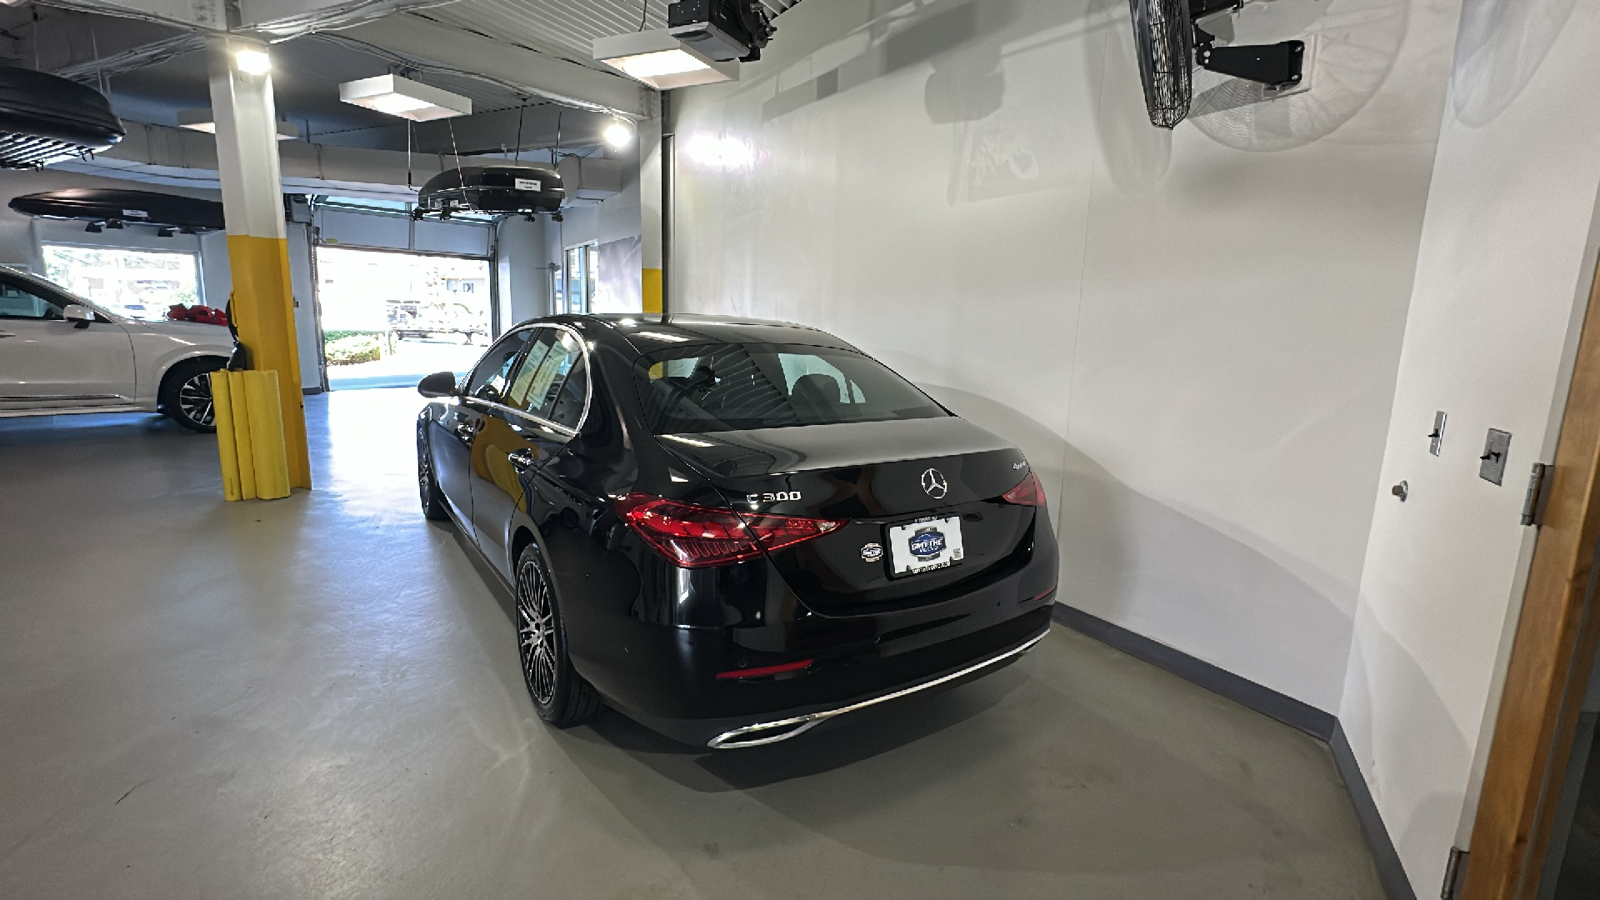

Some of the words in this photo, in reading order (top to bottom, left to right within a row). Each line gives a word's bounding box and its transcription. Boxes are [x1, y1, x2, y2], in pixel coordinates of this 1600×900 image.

[746, 493, 759, 504] C
[762, 491, 802, 503] 300
[911, 538, 943, 551] SMYTHE
